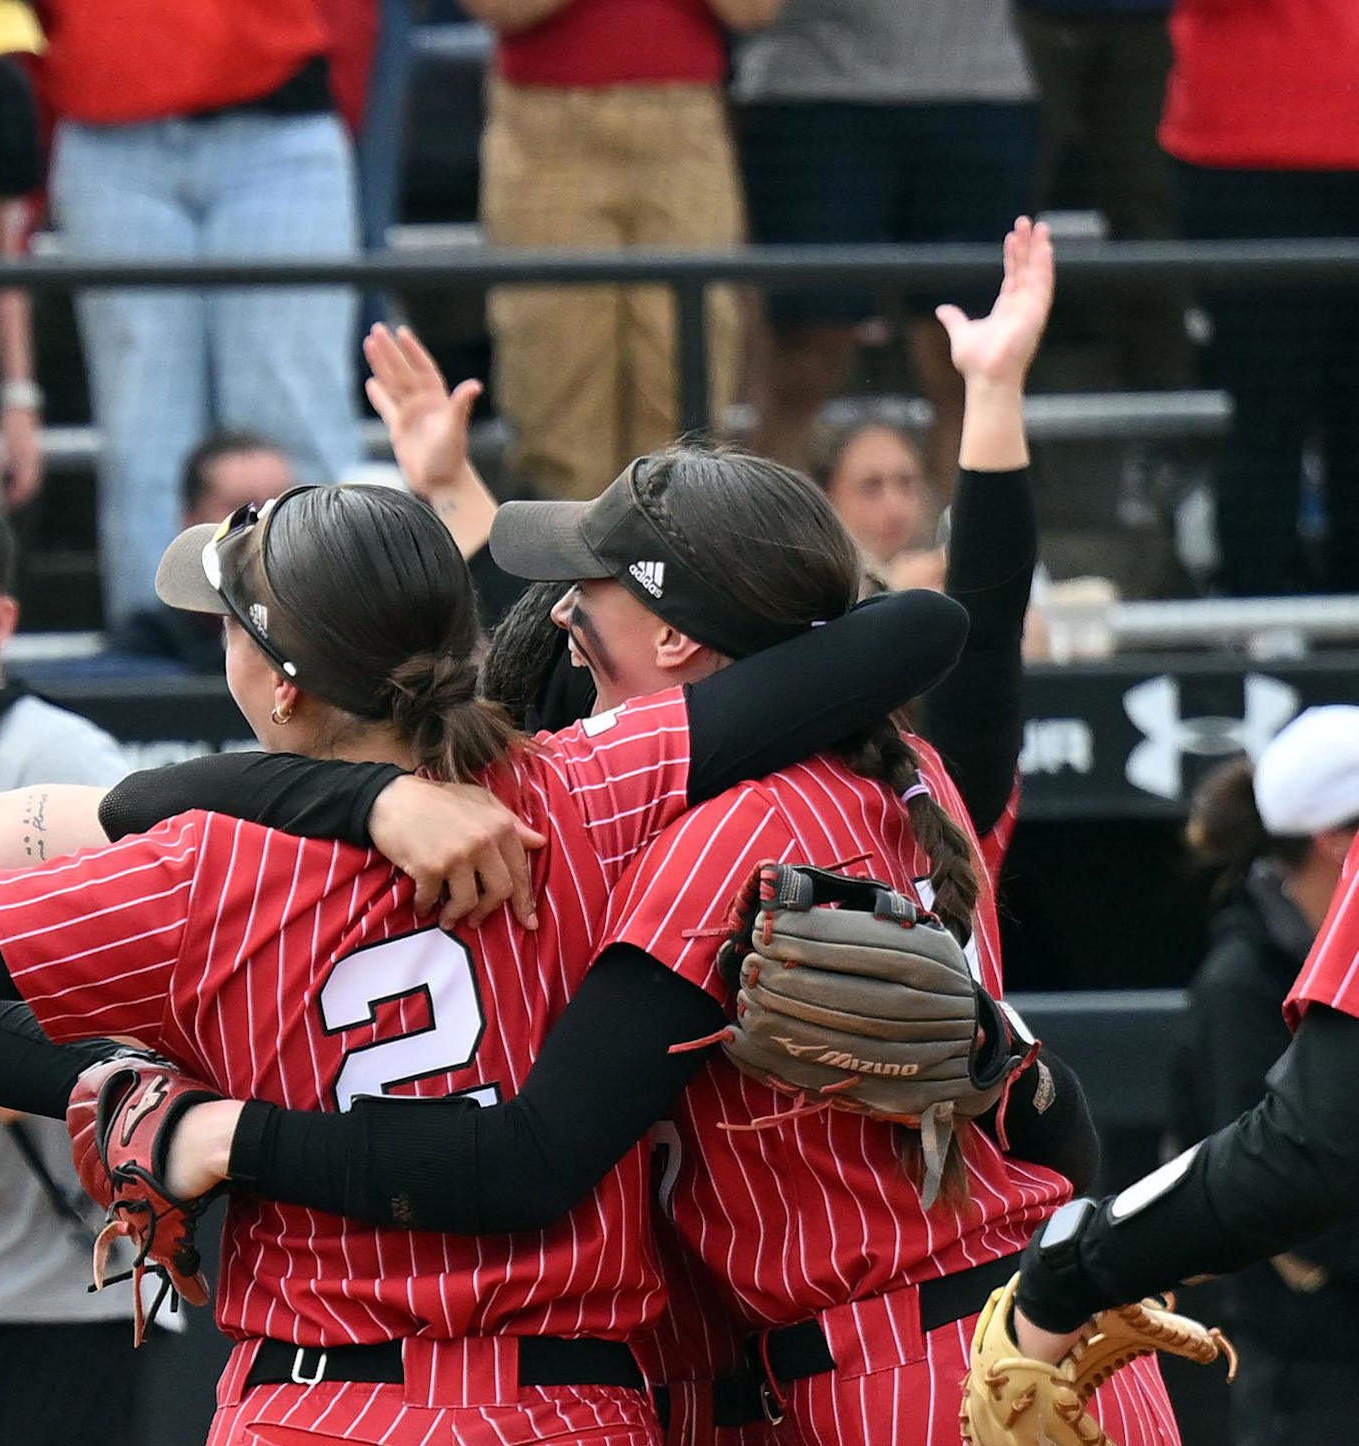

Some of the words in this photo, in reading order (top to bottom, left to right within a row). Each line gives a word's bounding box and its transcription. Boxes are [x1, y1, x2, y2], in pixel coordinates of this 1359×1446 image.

[629, 564, 663, 599] adidas
[318, 922, 503, 1116] 2
[815, 1050, 920, 1077] Mizuno
